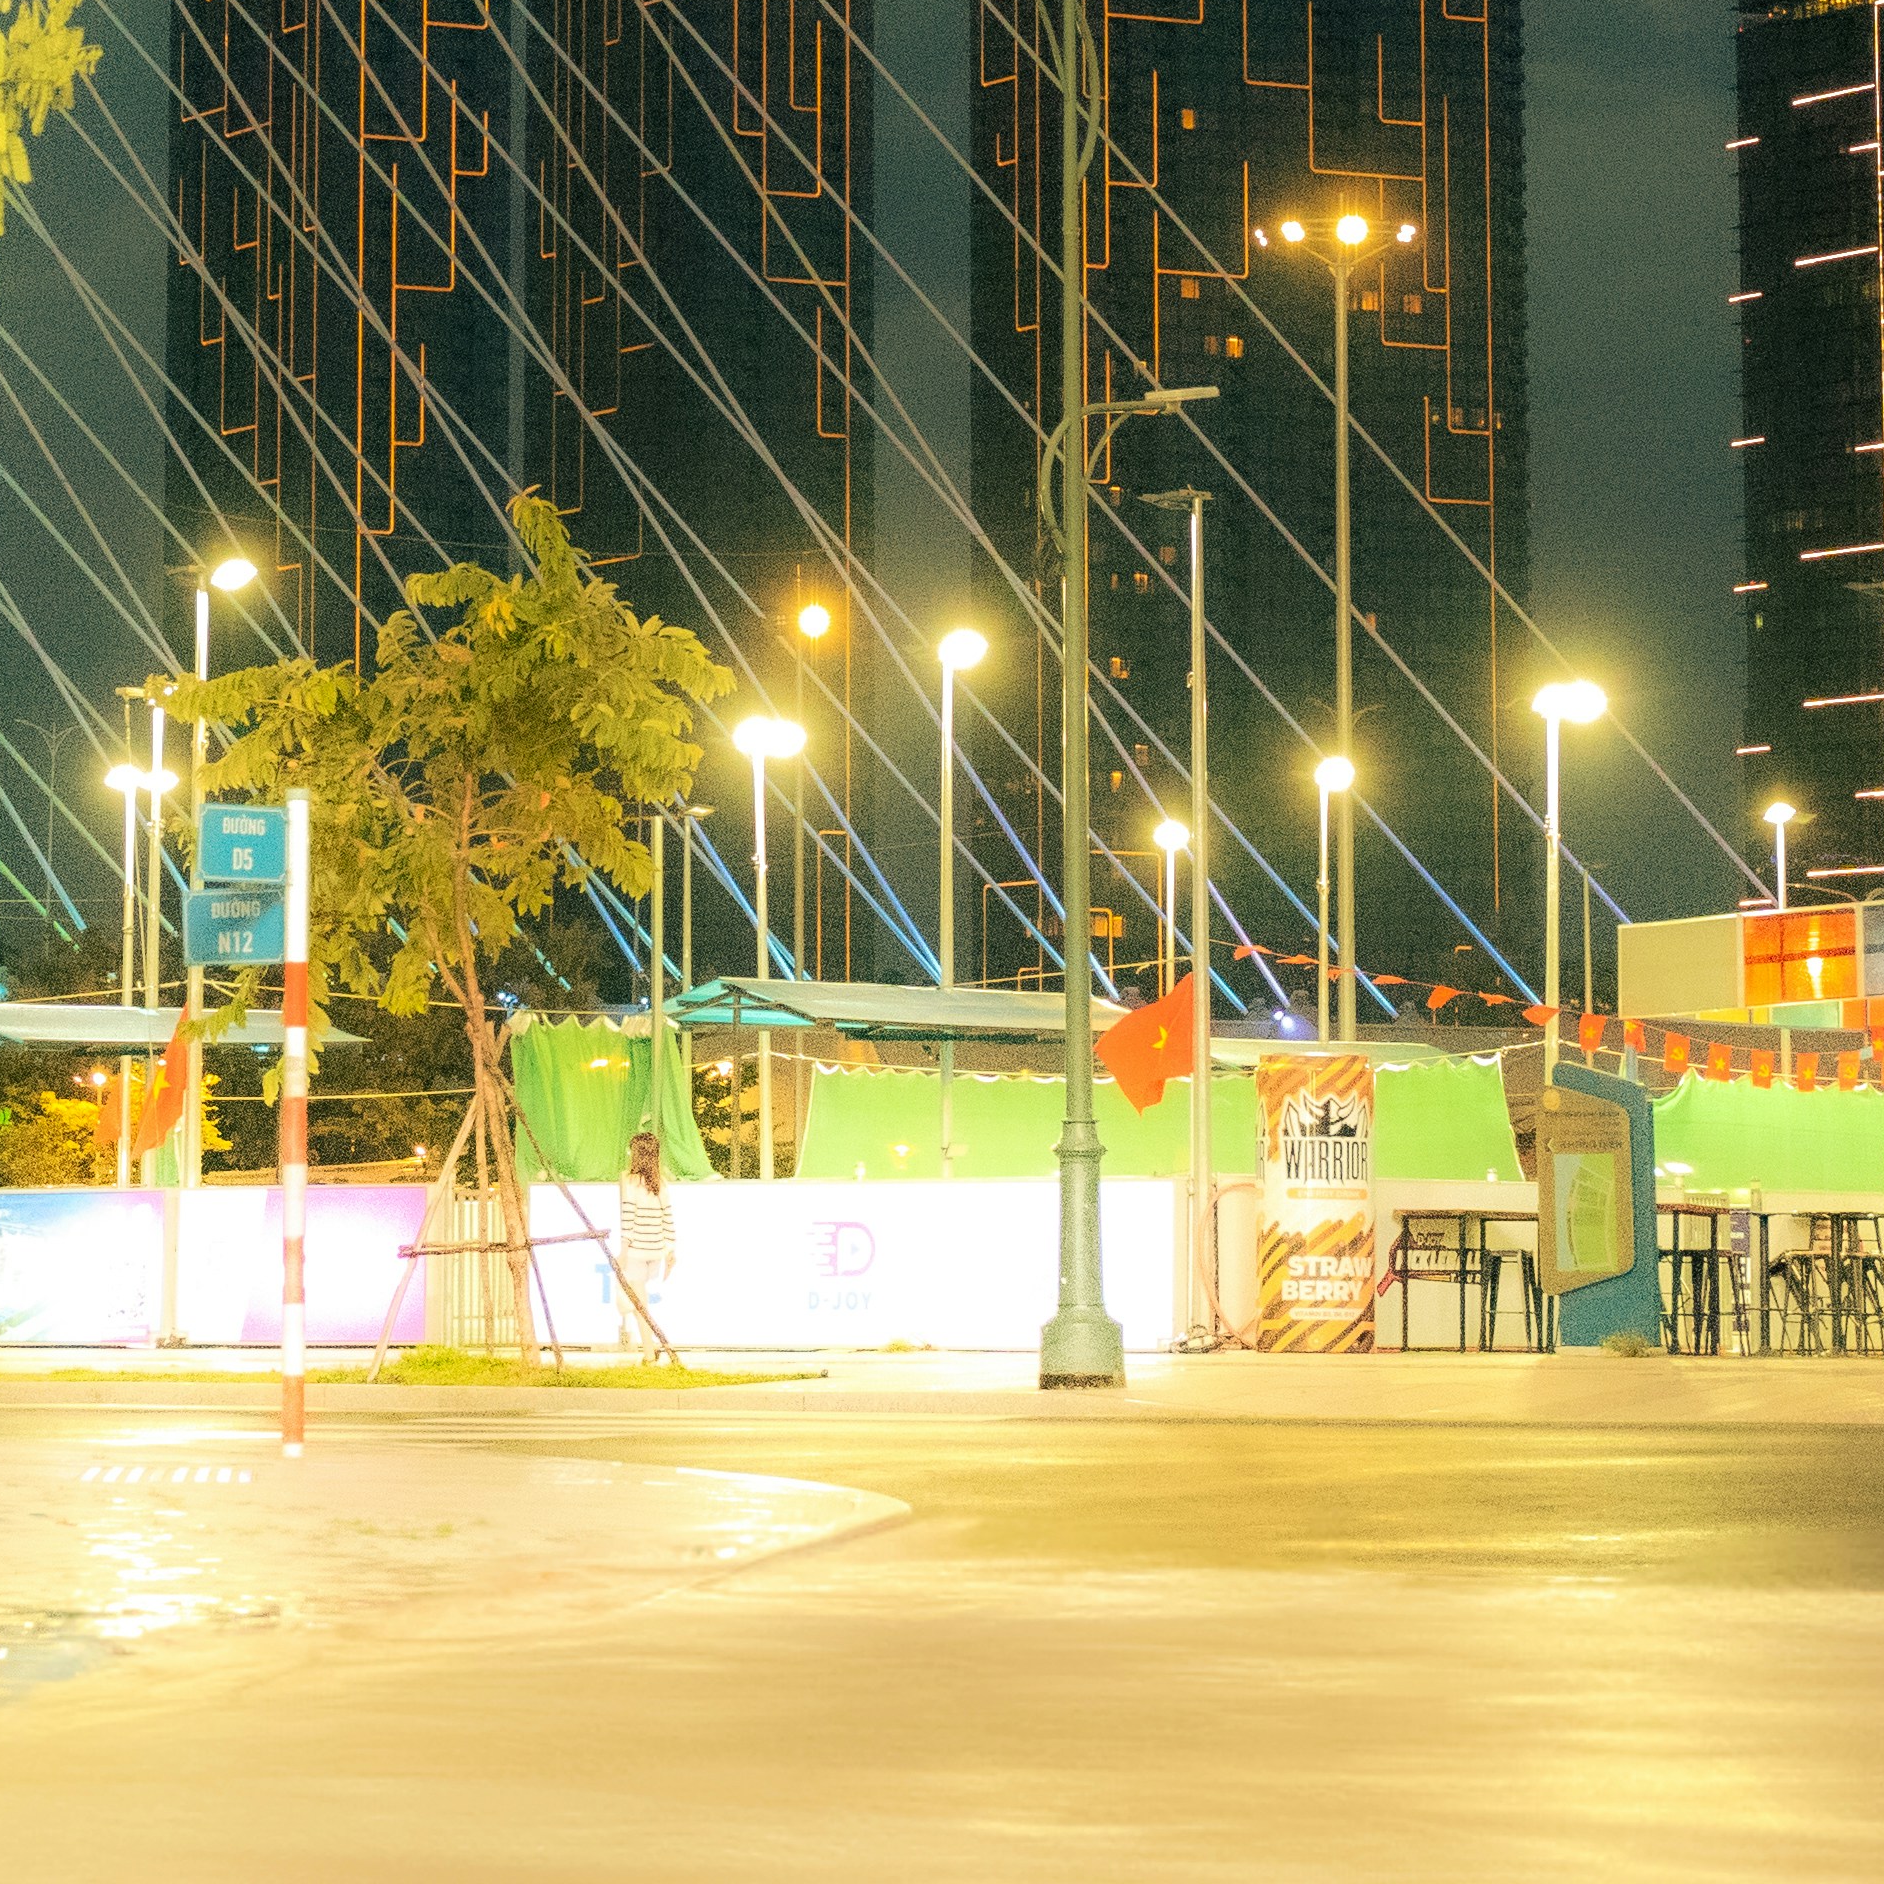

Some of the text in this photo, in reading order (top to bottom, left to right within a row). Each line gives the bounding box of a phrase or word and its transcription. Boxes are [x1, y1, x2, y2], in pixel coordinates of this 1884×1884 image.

[222, 814, 266, 836] ĐƯỜNG
[232, 847, 254, 871] D5
[211, 895, 261, 919] ĐƯỜNG
[218, 930, 254, 954] N12
[1283, 1139, 1369, 1186] WARRIOR
[1287, 1255, 1373, 1278] STRAW
[808, 1291, 873, 1310] D-JOY
[1281, 1279, 1363, 1301] BERRY
